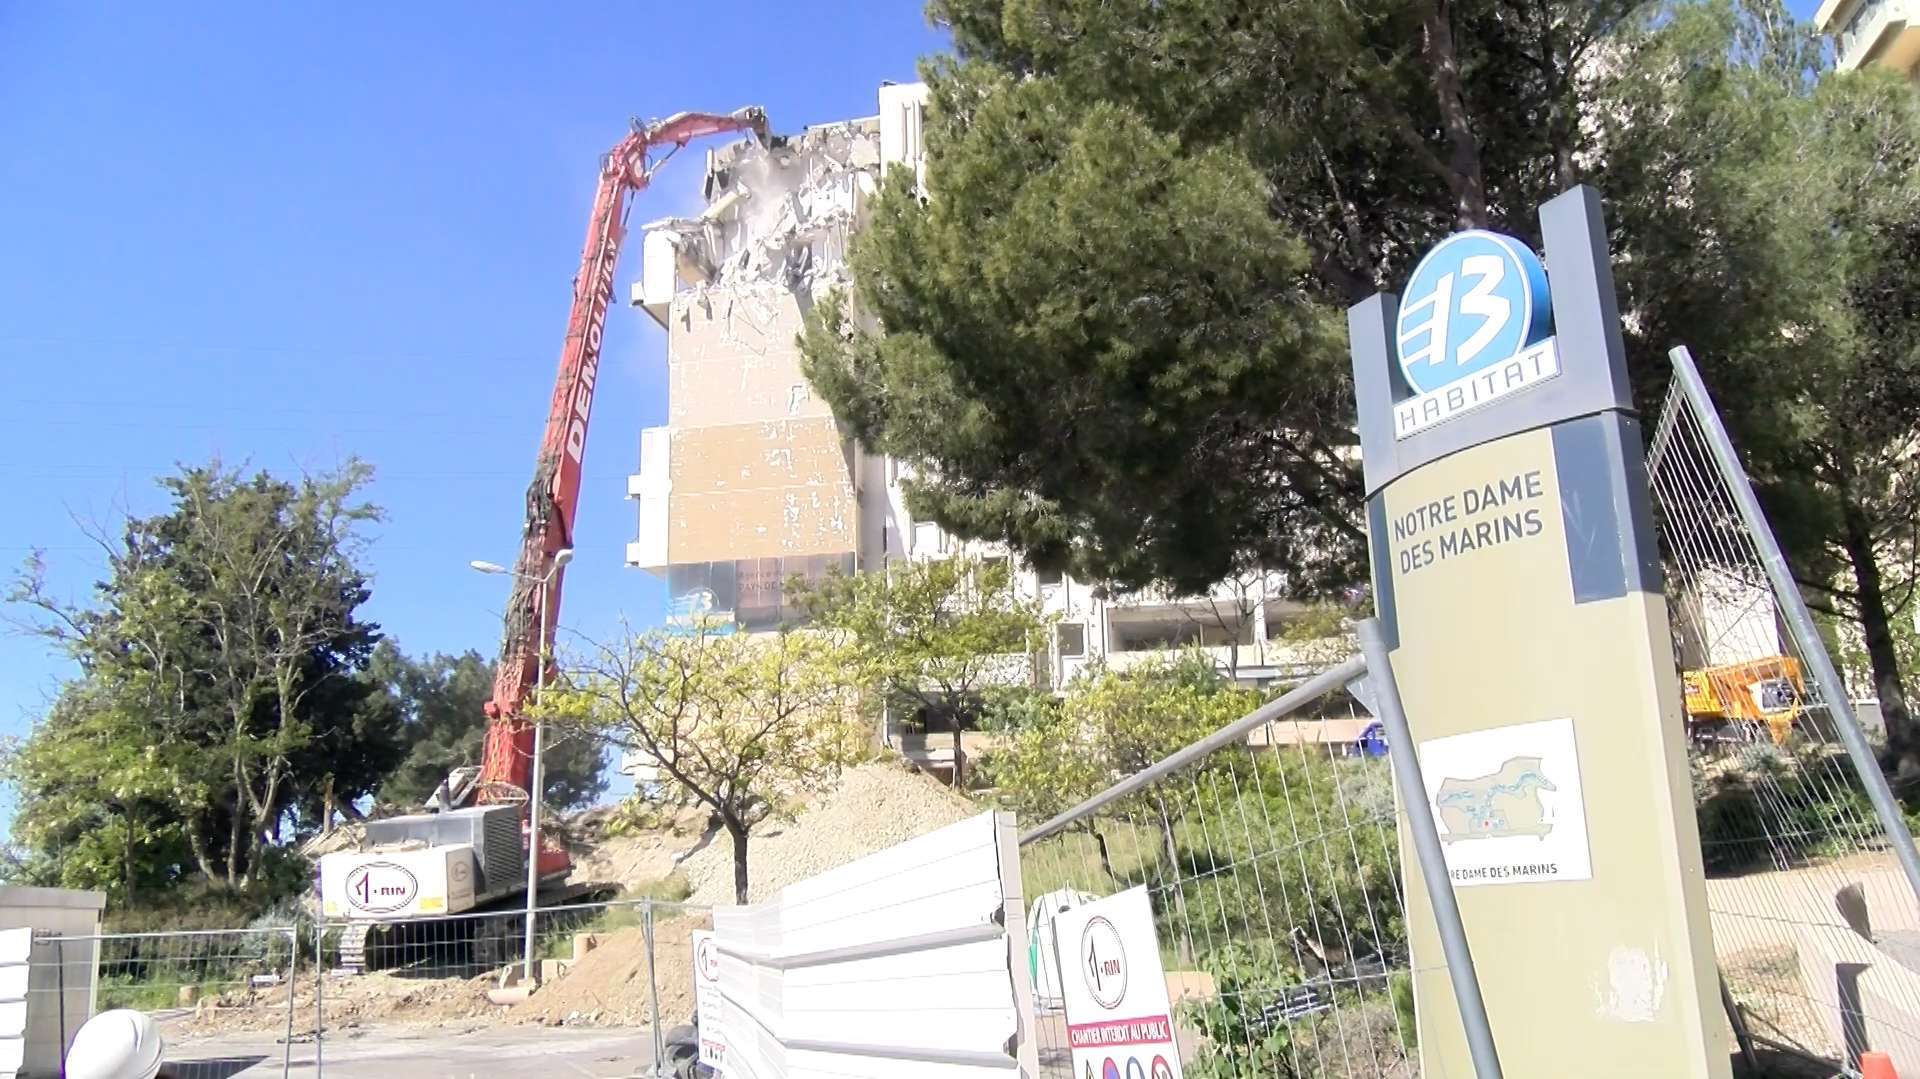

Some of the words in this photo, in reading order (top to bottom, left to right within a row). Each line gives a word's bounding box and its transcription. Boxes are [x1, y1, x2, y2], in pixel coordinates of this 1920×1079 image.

[1401, 255, 1511, 366] 13
[1400, 350, 1546, 431] HABITAT
[1393, 495, 1458, 542] NOTRE
[1465, 470, 1544, 514] DAME
[1400, 541, 1435, 575] DES
[1439, 508, 1543, 560] MARINS
[1462, 867, 1488, 880] DAME
[1490, 866, 1510, 878] DES
[1512, 863, 1558, 876] MARINS
[1071, 1027, 1101, 1046] CHANTIER
[1100, 1025, 1130, 1043] INTERDIT
[1130, 1023, 1141, 1041] AU
[1140, 1020, 1168, 1041] PUBLIC
